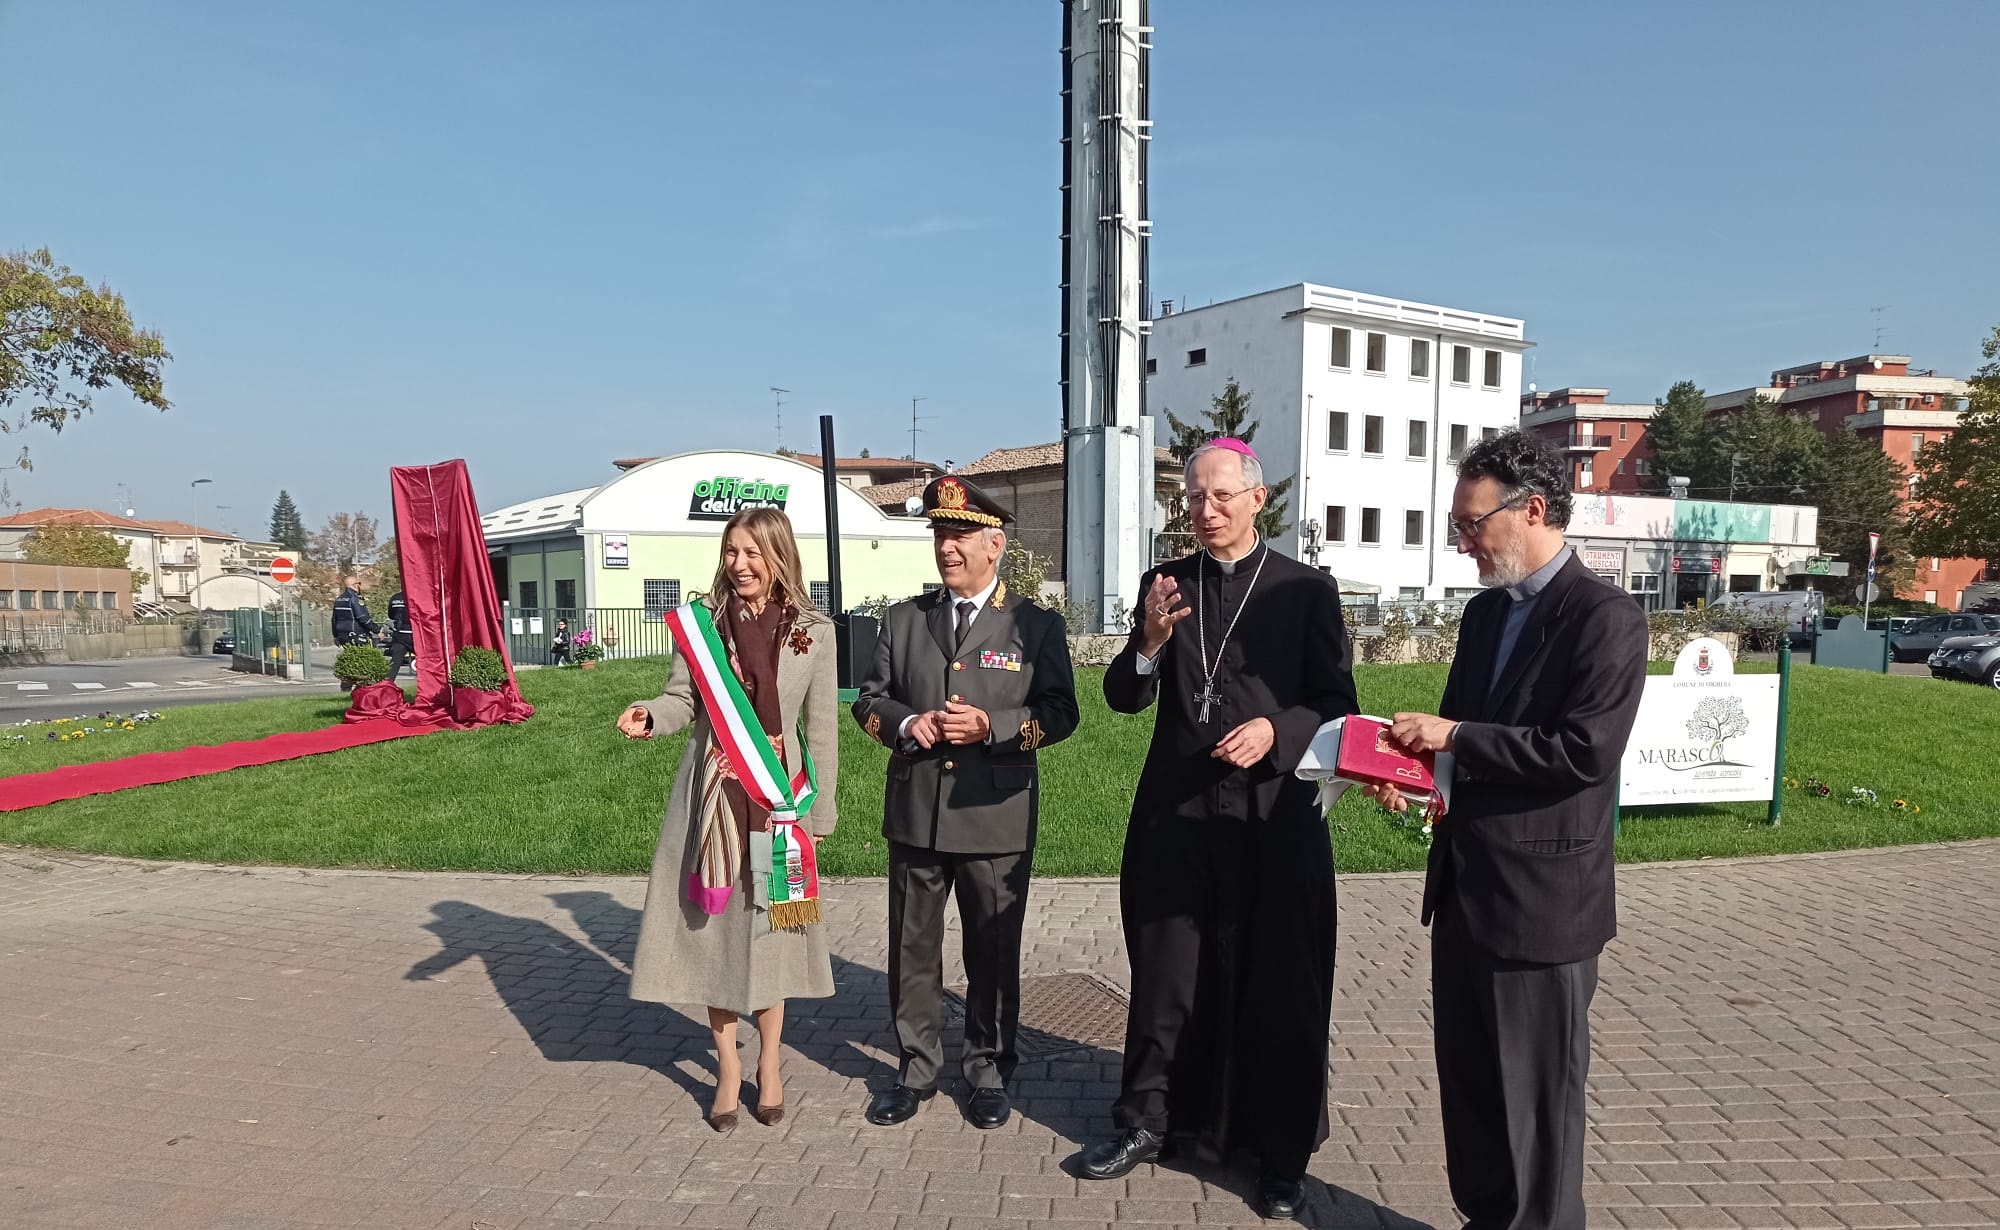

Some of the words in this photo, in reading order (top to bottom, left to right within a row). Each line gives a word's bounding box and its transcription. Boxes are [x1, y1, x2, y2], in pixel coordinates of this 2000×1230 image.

[694, 476, 790, 501] officina
[1585, 551, 1621, 560] STRUMENTI
[1587, 560, 1621, 568] MUSICALI
[1638, 741, 1724, 764] MARASCO
